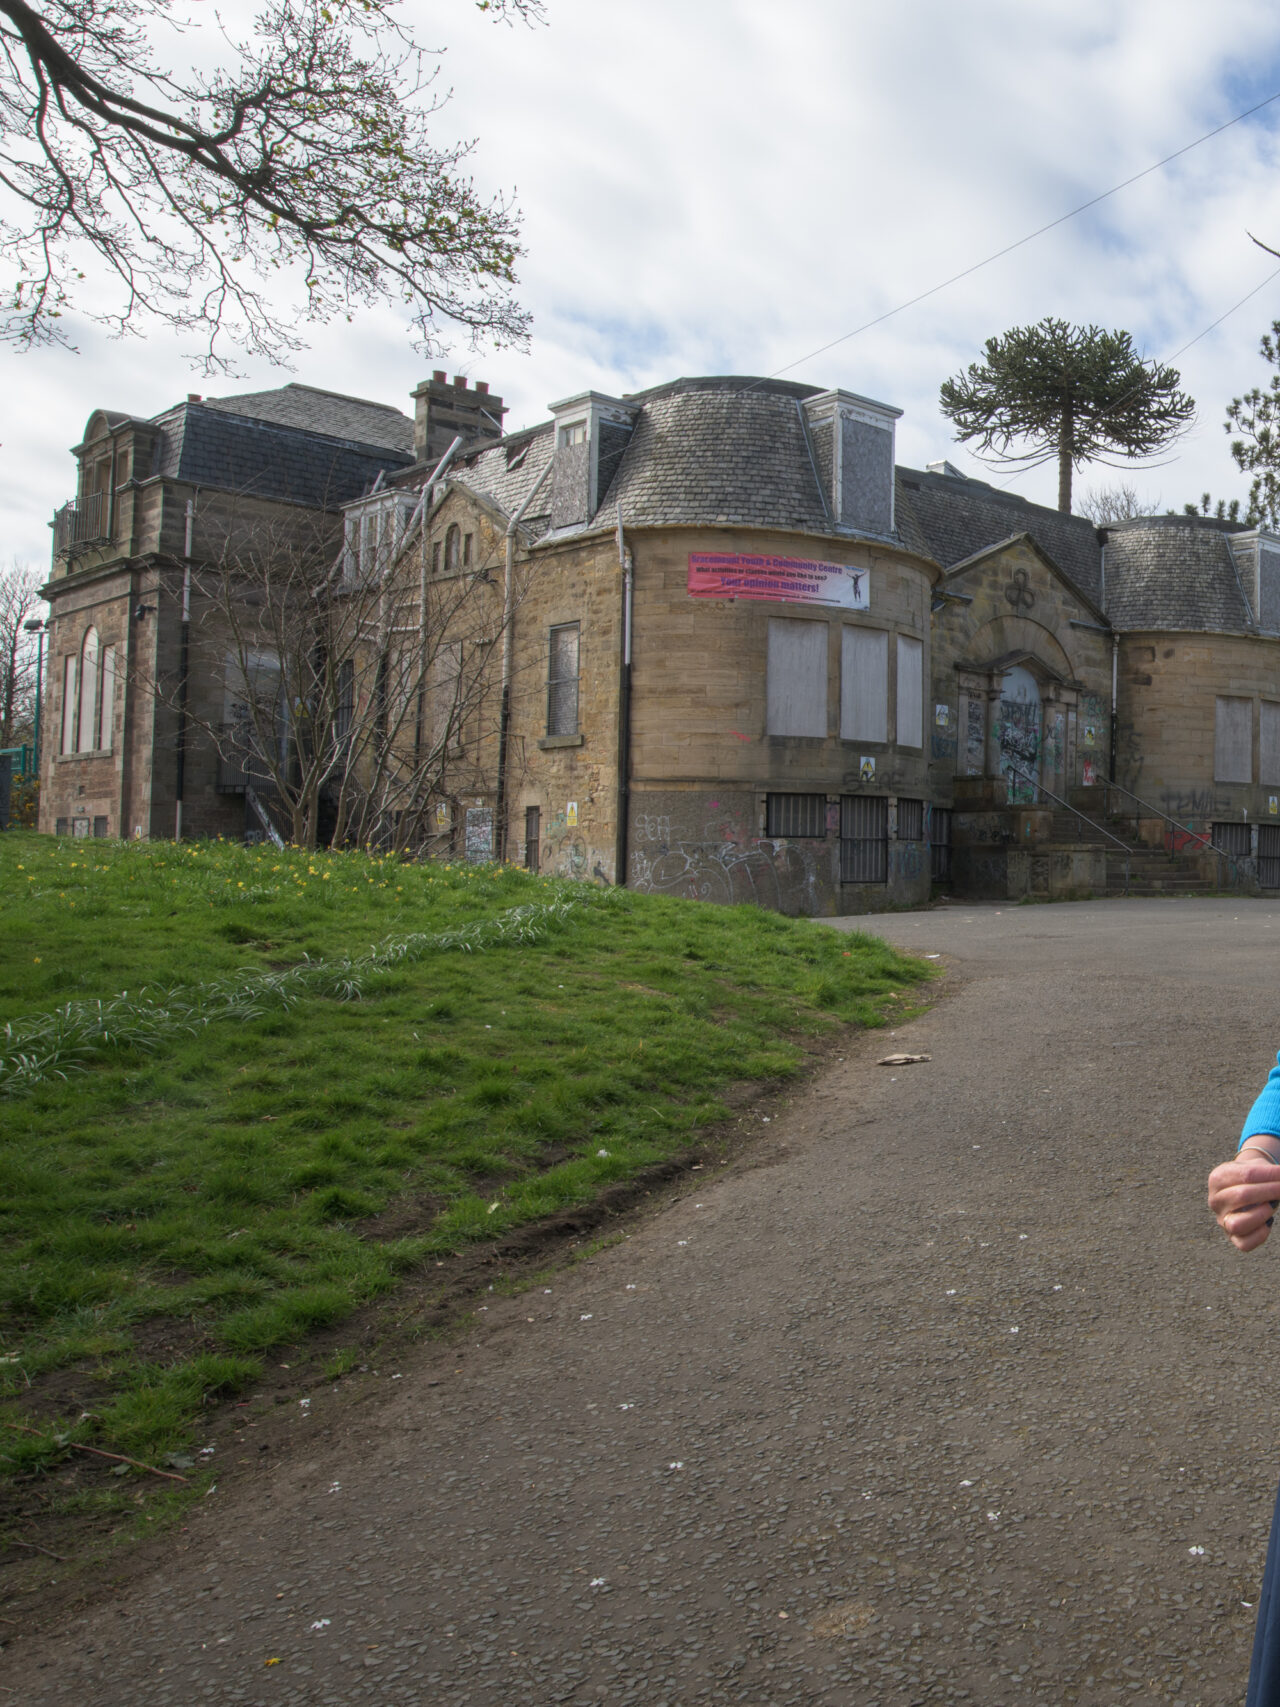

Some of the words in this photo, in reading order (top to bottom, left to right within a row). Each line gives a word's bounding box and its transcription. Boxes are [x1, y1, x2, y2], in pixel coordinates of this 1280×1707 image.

[773, 558, 817, 572] Community
[818, 563, 843, 575] Centre
[782, 581, 819, 593] matters!
